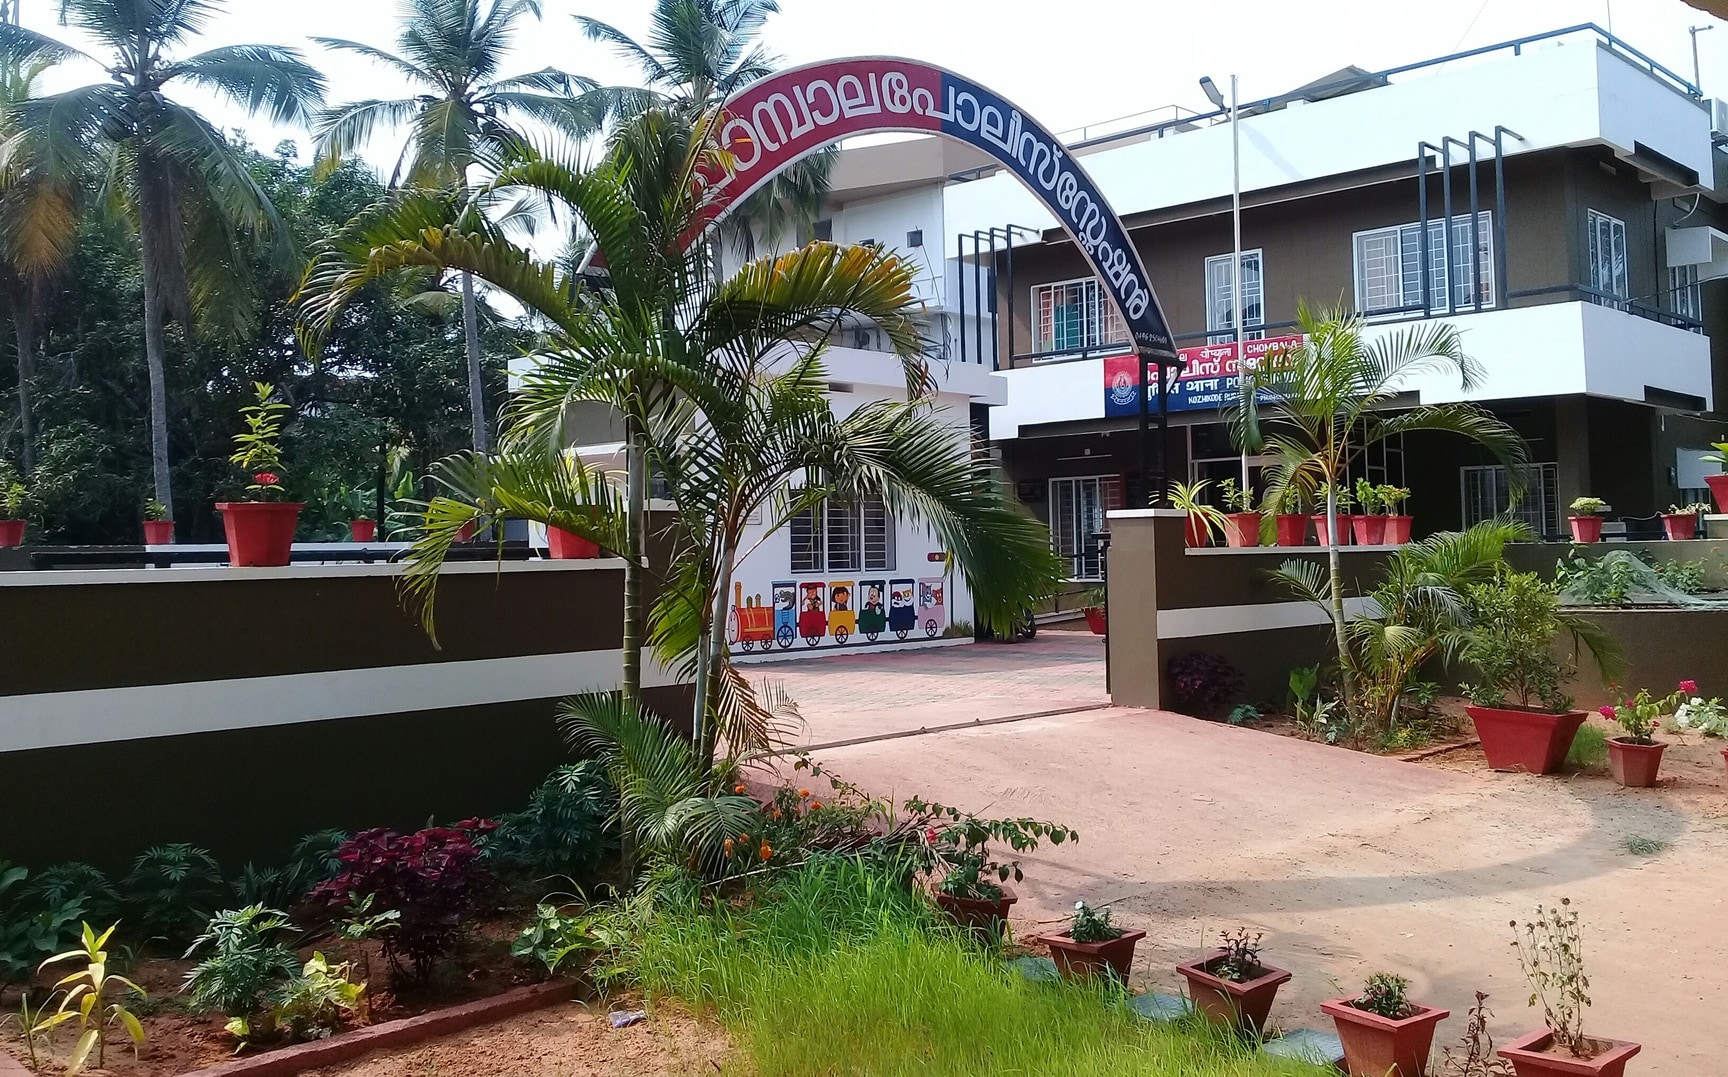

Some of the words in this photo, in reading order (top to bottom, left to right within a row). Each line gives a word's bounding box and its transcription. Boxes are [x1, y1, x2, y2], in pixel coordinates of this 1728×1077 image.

[1246, 340, 1298, 354] CHOMBALA
[1186, 379, 1220, 392] थाना
[1188, 393, 1223, 404] KOZHIKODE
